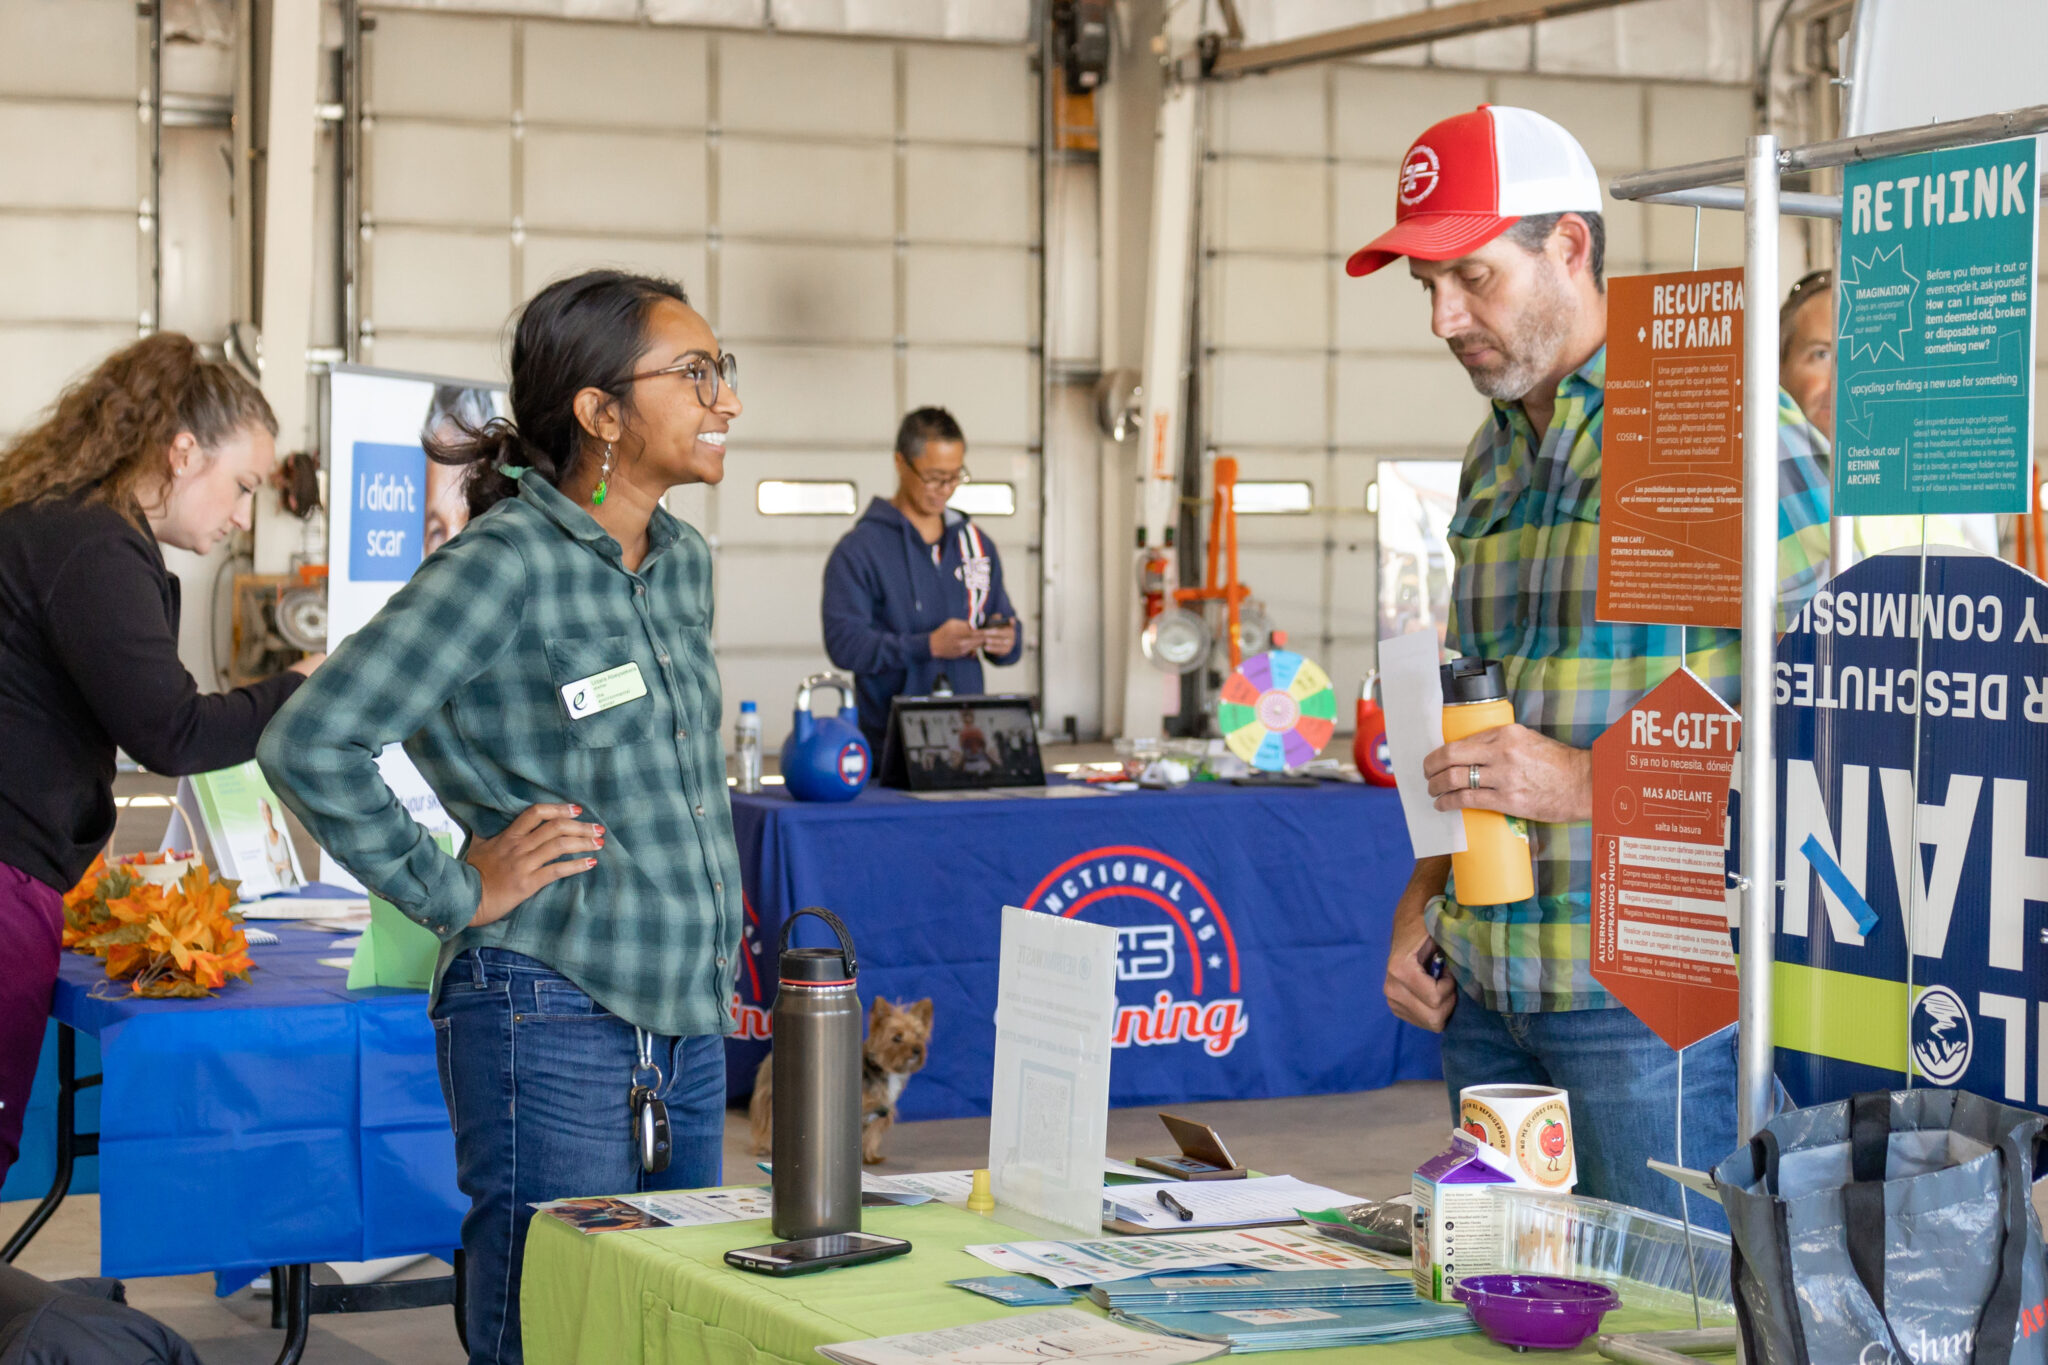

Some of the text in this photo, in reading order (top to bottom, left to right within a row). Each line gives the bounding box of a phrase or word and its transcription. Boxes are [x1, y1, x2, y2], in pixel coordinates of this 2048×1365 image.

[1852, 161, 2028, 235] RETHINK
[1926, 262, 2028, 281] Before you throw it out or
[1856, 284, 1910, 300] IMAGINATION
[1926, 286, 1945, 296] even
[1945, 282, 1971, 295] recycle
[1980, 279, 1994, 289] ask
[1653, 281, 1743, 315] RECUPERA
[1926, 299, 1943, 310] How
[1948, 300, 1962, 308] can
[1974, 294, 2007, 308] imagine
[2011, 291, 2027, 302] this
[1925, 307, 2026, 325] item deemed old, broken
[1652, 316, 1731, 349] REPARAR
[1925, 325, 1997, 341] or disposable into
[1925, 339, 1990, 355] something new?
[1606, 380, 1644, 389] DOBLADILLO
[1851, 382, 1885, 396] upcycling
[1887, 383, 1895, 392] or
[1896, 379, 1922, 393] finding
[1930, 380, 1946, 389] new
[1947, 379, 1961, 388] use
[1962, 375, 1974, 387] for
[1975, 374, 2018, 387] something
[1612, 407, 1641, 416] PARCHAR
[1616, 433, 1637, 441] COSER
[1848, 446, 1900, 457] Check-out our
[1848, 459, 1880, 472] RETHINK
[1847, 474, 1881, 485] ARCHIVE
[360, 472, 417, 513] I didn't
[366, 528, 406, 557] scar
[1612, 536, 1628, 544] REPAIR
[1611, 548, 1633, 556] (CENTRO
[2013, 597, 2048, 644] Y
[1776, 662, 2007, 720] DESCHUTES
[1632, 710, 1738, 751] RE-GIFT
[1630, 755, 1638, 766] Si
[1639, 757, 1649, 768] ya
[1650, 757, 1660, 767] no
[1662, 757, 1669, 768] lo
[1643, 787, 1712, 803] MAS ADELANTE
[1620, 801, 1628, 810] tu
[1655, 822, 1702, 835] salta la basura
[1776, 757, 2048, 973] HAN
[1044, 861, 1216, 941] NCTIONAL 45
[1598, 872, 1607, 963] ALTERNATIVAS A
[1607, 883, 1616, 961] COMPRANDO
[1111, 989, 1248, 1062] ning
